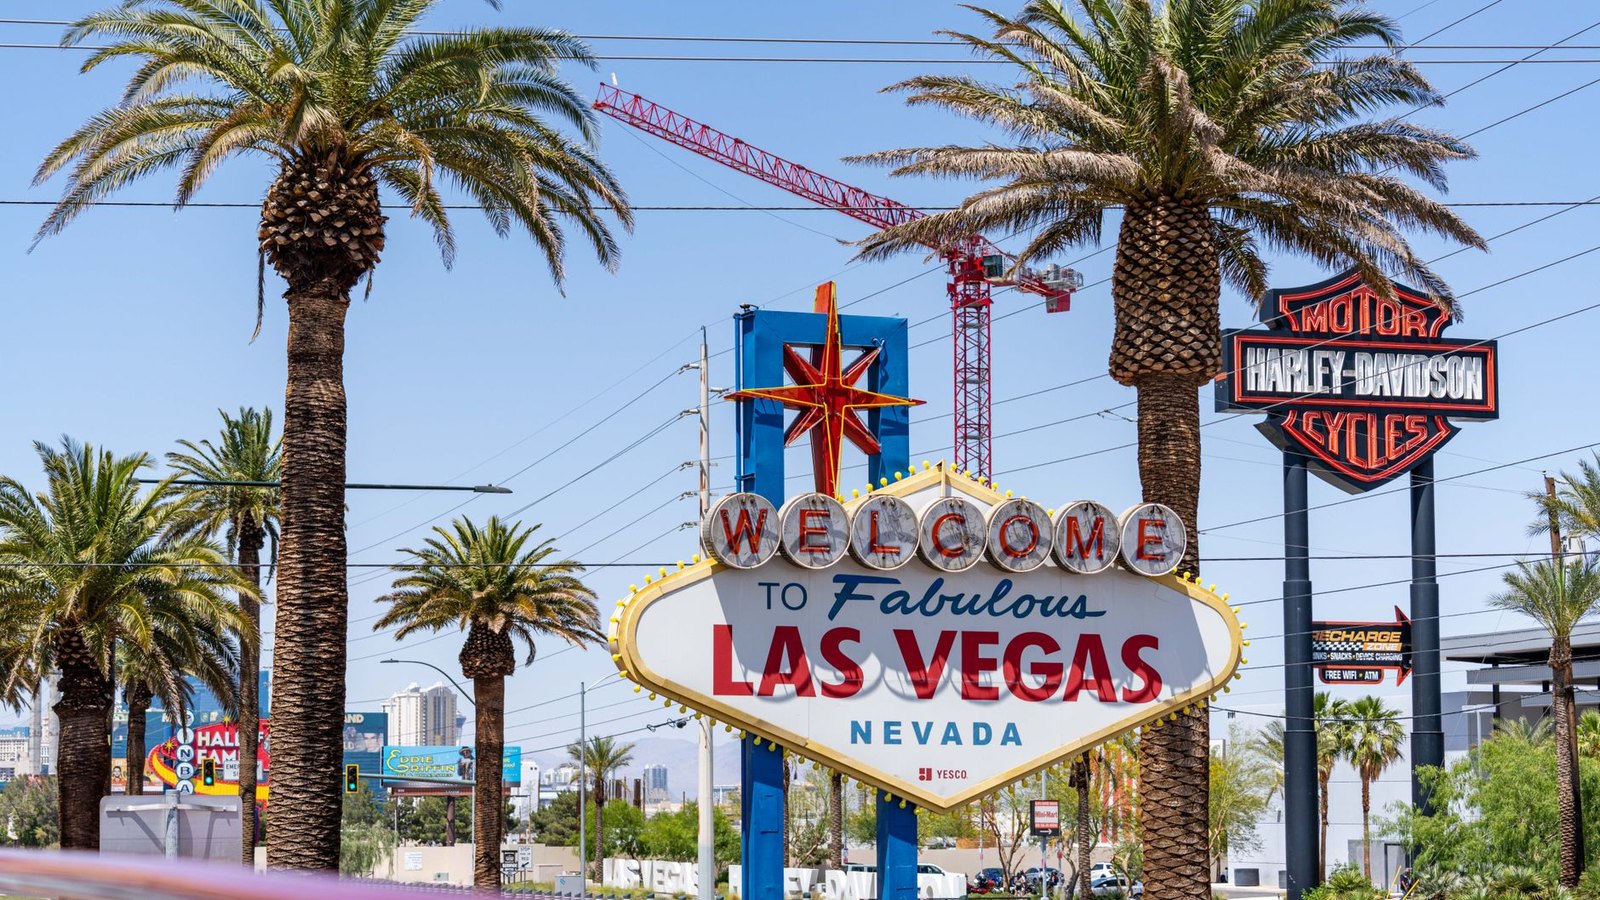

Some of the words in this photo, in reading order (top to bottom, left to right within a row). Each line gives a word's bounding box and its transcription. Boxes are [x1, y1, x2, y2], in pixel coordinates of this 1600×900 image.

[1302, 286, 1428, 337] MOTOR
[1246, 347, 1483, 400] HARLEY-DAVIDSON
[1303, 410, 1428, 469] CYCLES
[719, 509, 1167, 561] WELCOME
[758, 582, 808, 610] TO
[827, 574, 1106, 621] Fabulous
[713, 624, 865, 698] LAS
[893, 628, 1162, 703] VEGAS
[1355, 653, 1375, 661] DEVICE
[1375, 653, 1402, 661] CHARGING
[1366, 643, 1398, 651] ZONE
[1325, 670, 1341, 679] FREE
[1342, 670, 1357, 680] WIFI
[1364, 671, 1379, 680] ATM
[851, 720, 1022, 746] NEVADA
[936, 769, 967, 779] YESCO
